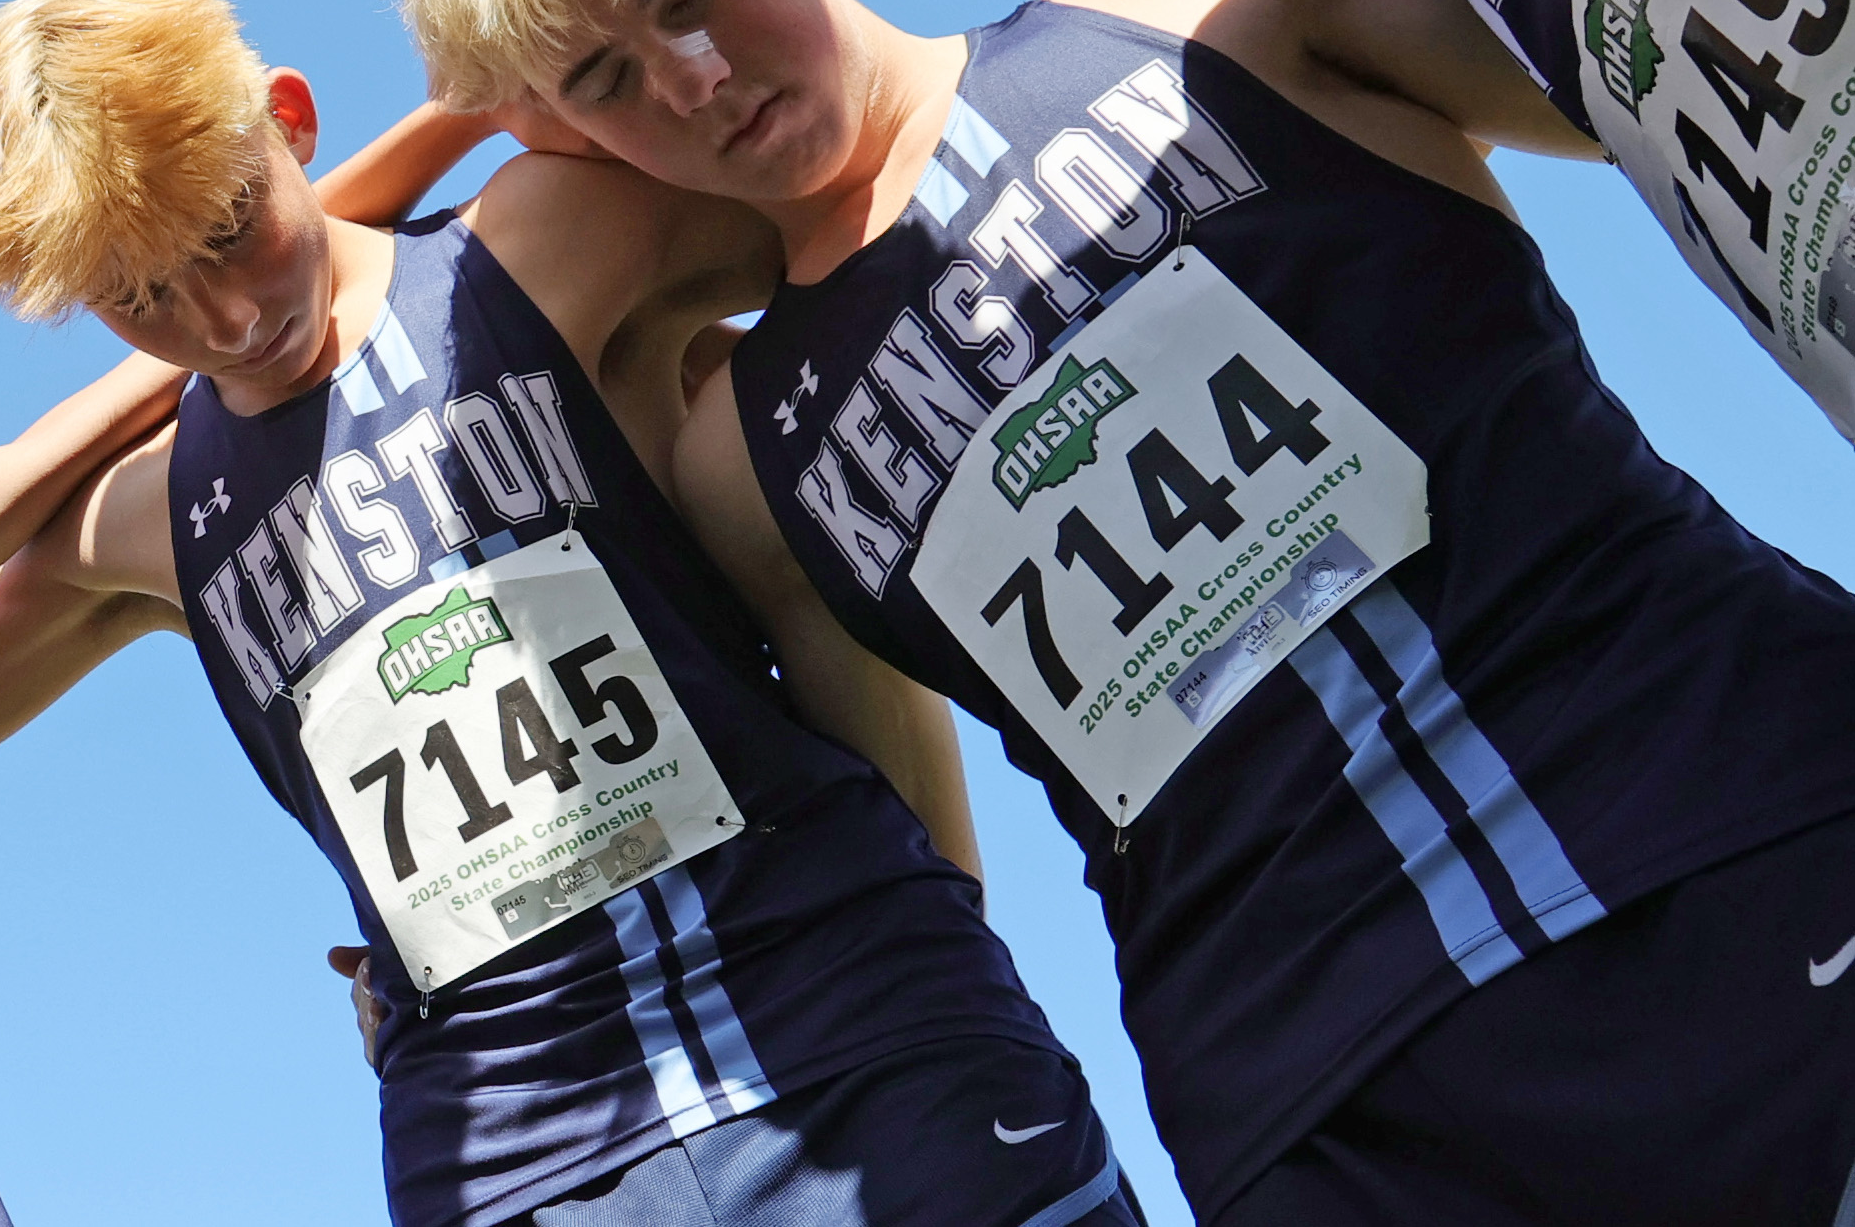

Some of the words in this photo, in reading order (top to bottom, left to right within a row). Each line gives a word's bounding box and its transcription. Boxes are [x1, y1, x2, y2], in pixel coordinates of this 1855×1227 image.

[1787, 124, 1837, 207] Cross
[1803, 135, 1855, 274] Champio
[1778, 212, 1800, 301] OHSAA
[1801, 278, 1817, 343] State
[795, 58, 1268, 601] KENSTON
[999, 367, 1125, 499] OHSAA
[199, 369, 600, 712] KENSTON
[980, 352, 1332, 711] 7144
[1079, 678, 1123, 735] 2025
[1122, 603, 1199, 679] OHSAA
[1197, 540, 1265, 601] Cross
[1265, 453, 1364, 538] Country
[382, 604, 504, 696] OHSAA
[1124, 661, 1180, 718] State
[1180, 512, 1340, 658] Championship
[348, 633, 660, 883] 7145
[406, 874, 453, 909] 2025
[455, 833, 529, 881] OHSAA
[531, 800, 592, 840] Cross
[595, 758, 681, 808] Country
[451, 877, 505, 912] State
[507, 800, 654, 880] Championship
